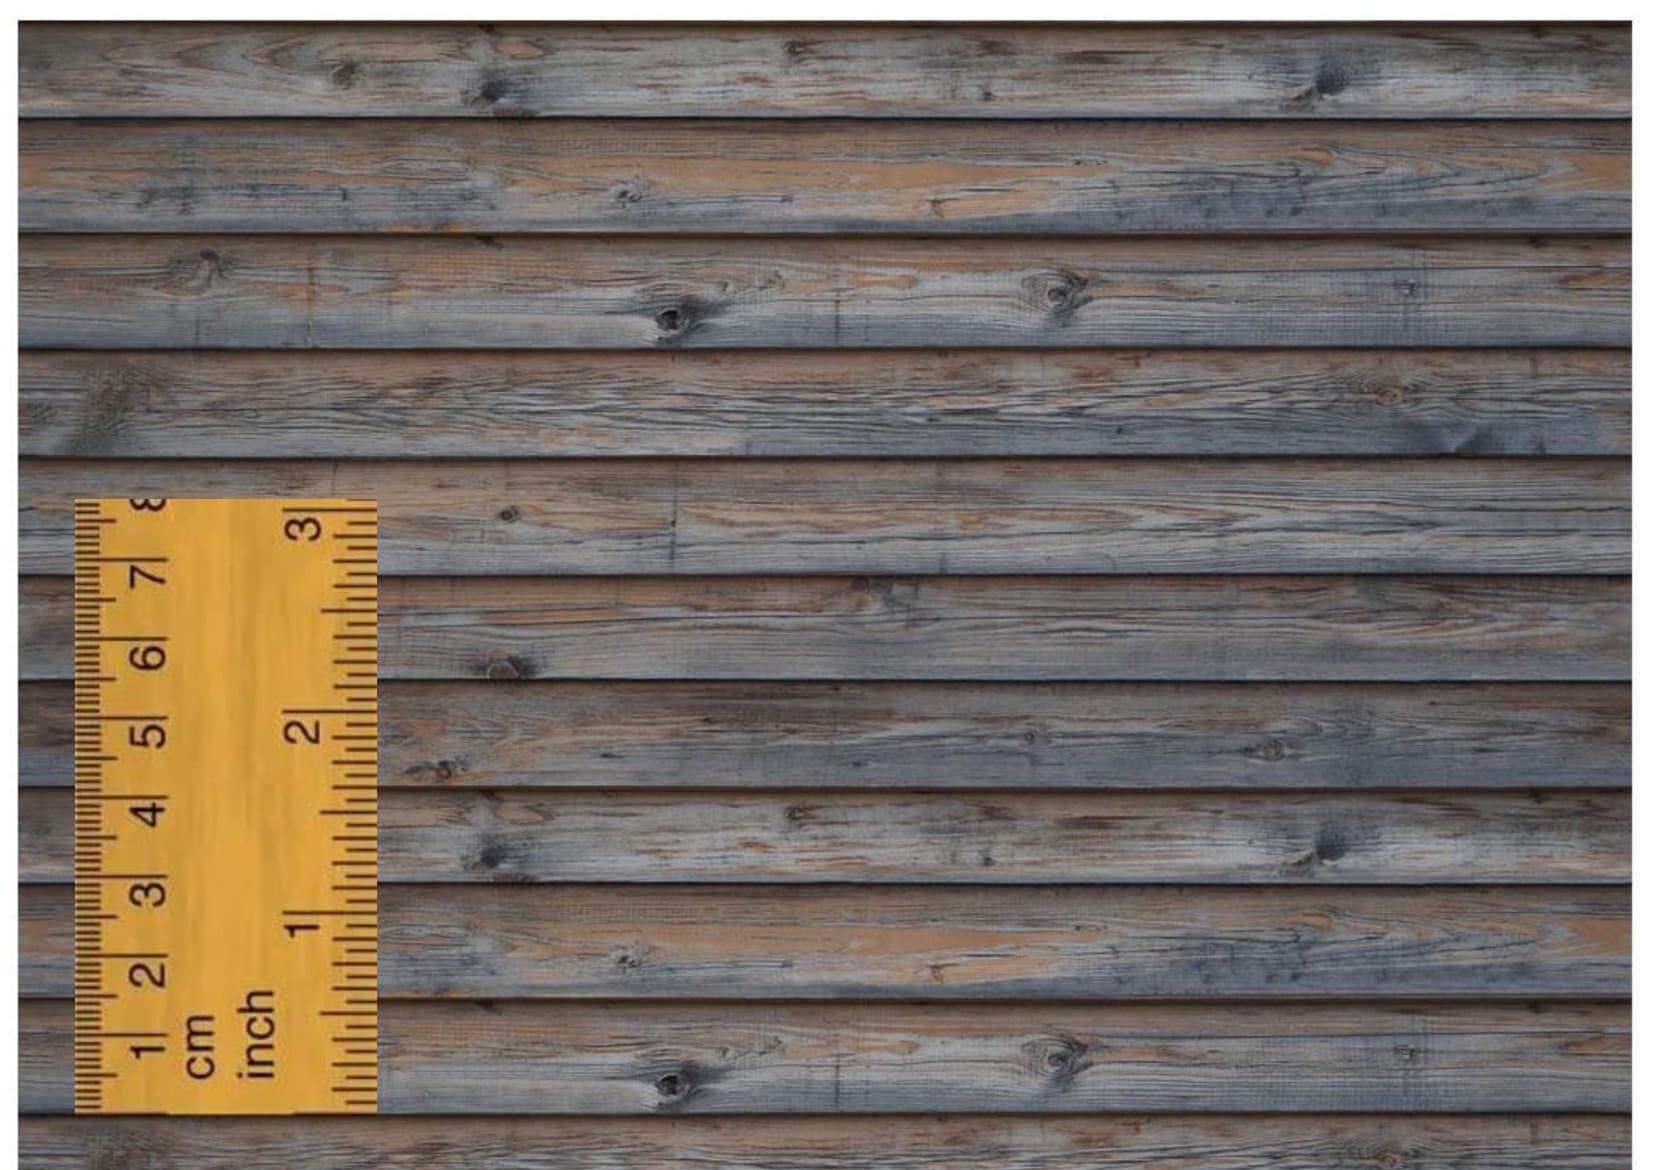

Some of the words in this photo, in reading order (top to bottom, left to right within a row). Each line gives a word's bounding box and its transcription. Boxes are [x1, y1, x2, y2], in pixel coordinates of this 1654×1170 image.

[285, 517, 322, 541] 3
[130, 564, 166, 590] 7
[129, 645, 166, 671] 6
[129, 724, 166, 749] 5
[284, 720, 320, 745] 2
[130, 802, 166, 828] 4
[129, 882, 166, 908] 3
[284, 924, 320, 938] 1
[129, 963, 166, 988] 2
[236, 990, 275, 1079] inch
[129, 1045, 166, 1060] 1
[186, 1015, 215, 1080] cm
